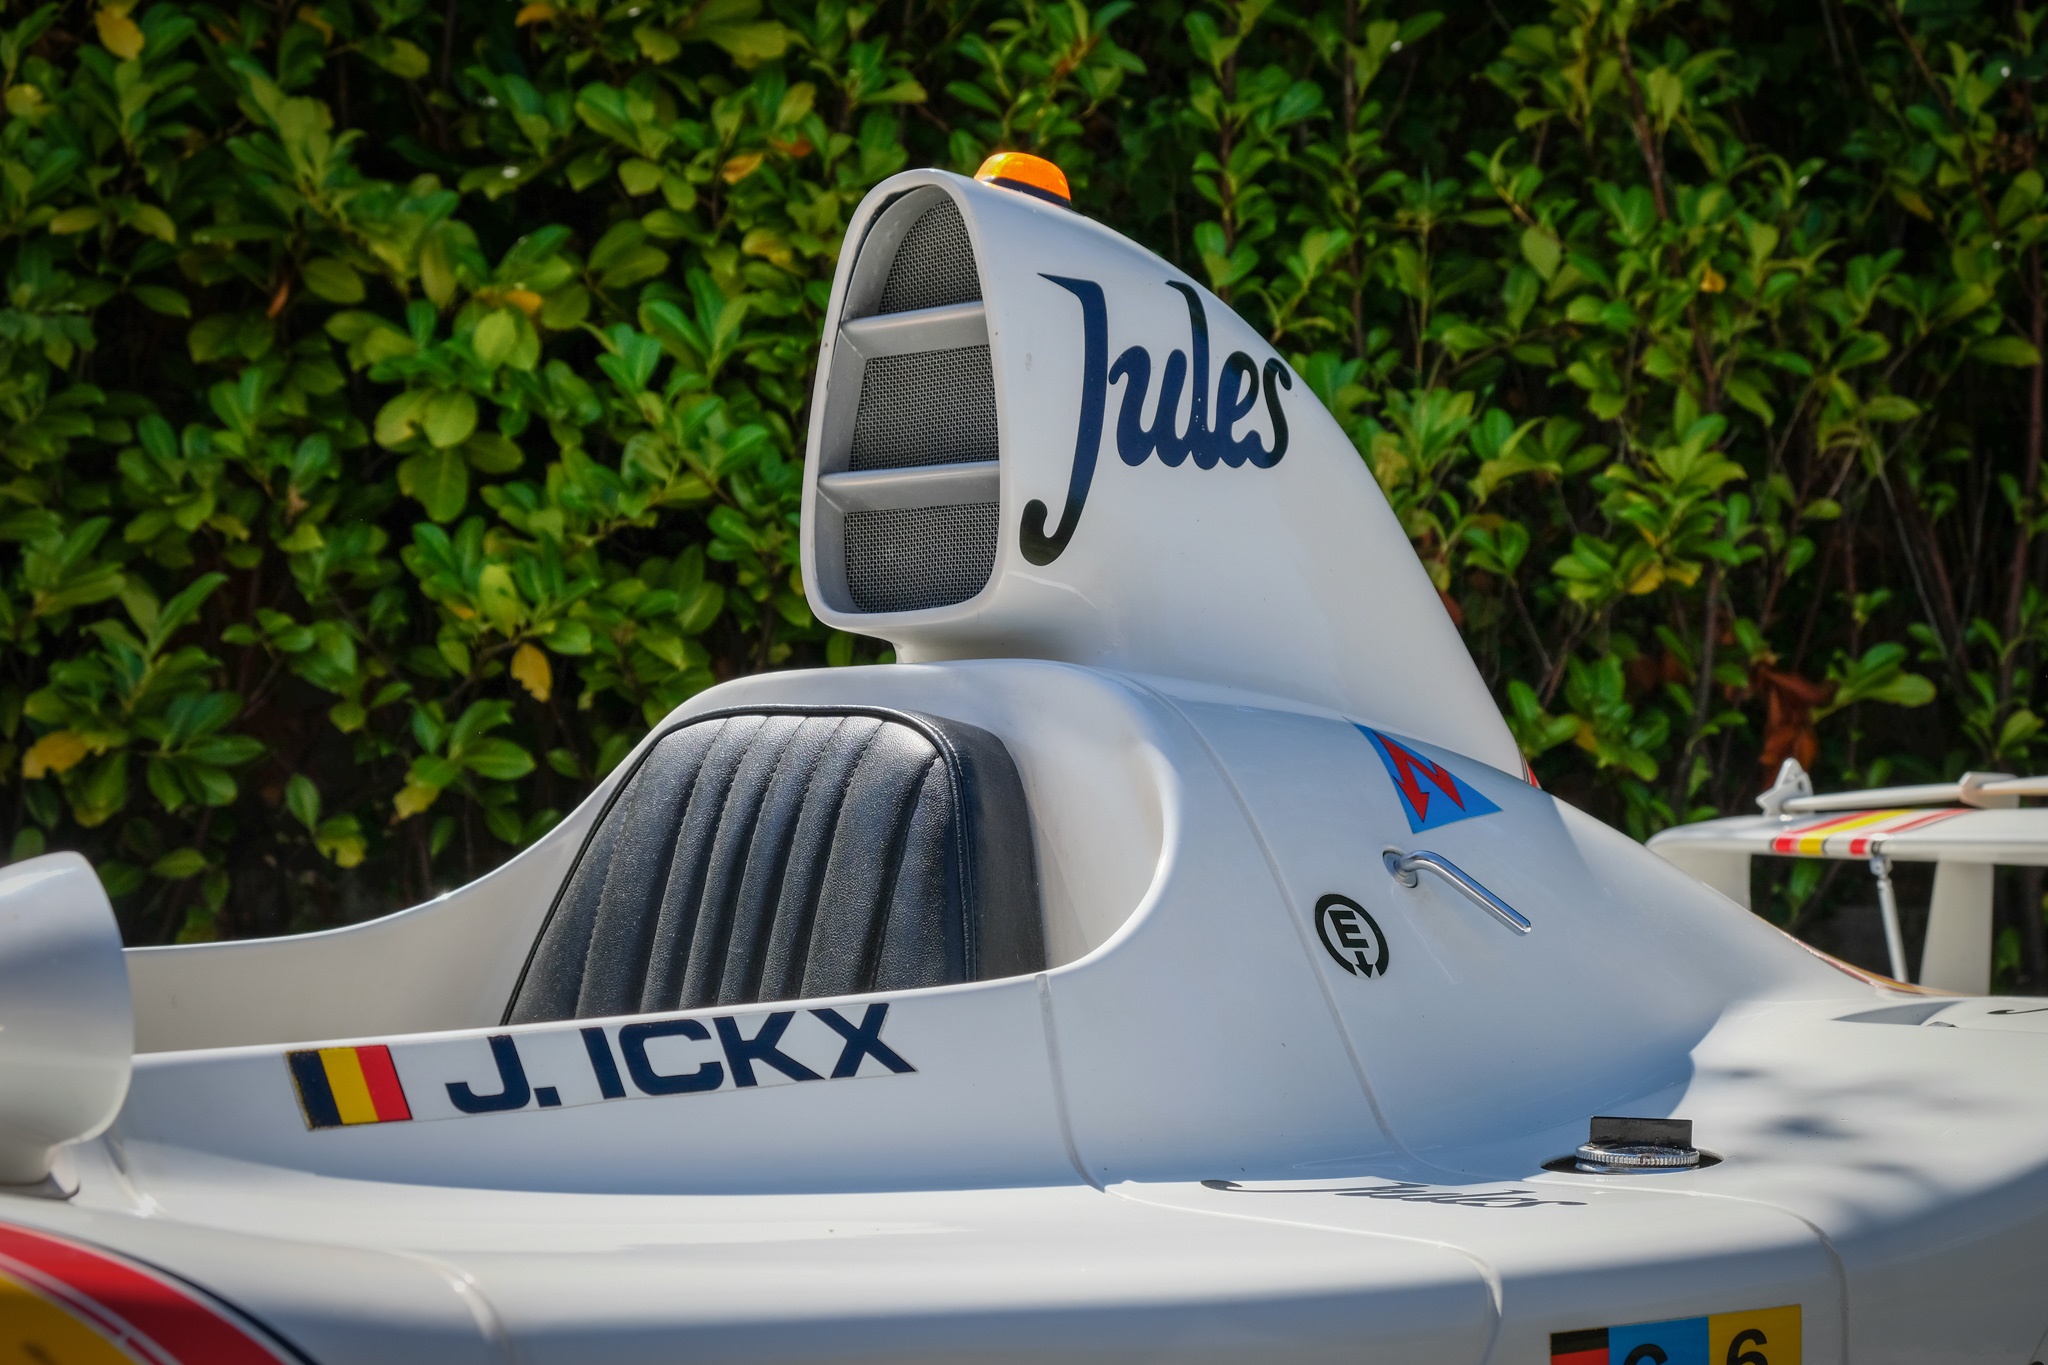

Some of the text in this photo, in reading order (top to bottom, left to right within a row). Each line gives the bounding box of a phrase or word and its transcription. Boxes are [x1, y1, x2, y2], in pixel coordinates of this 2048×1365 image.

[1019, 272, 1292, 566] Jules
[1328, 910, 1370, 948] E
[445, 1002, 918, 1114] J. ICKX
